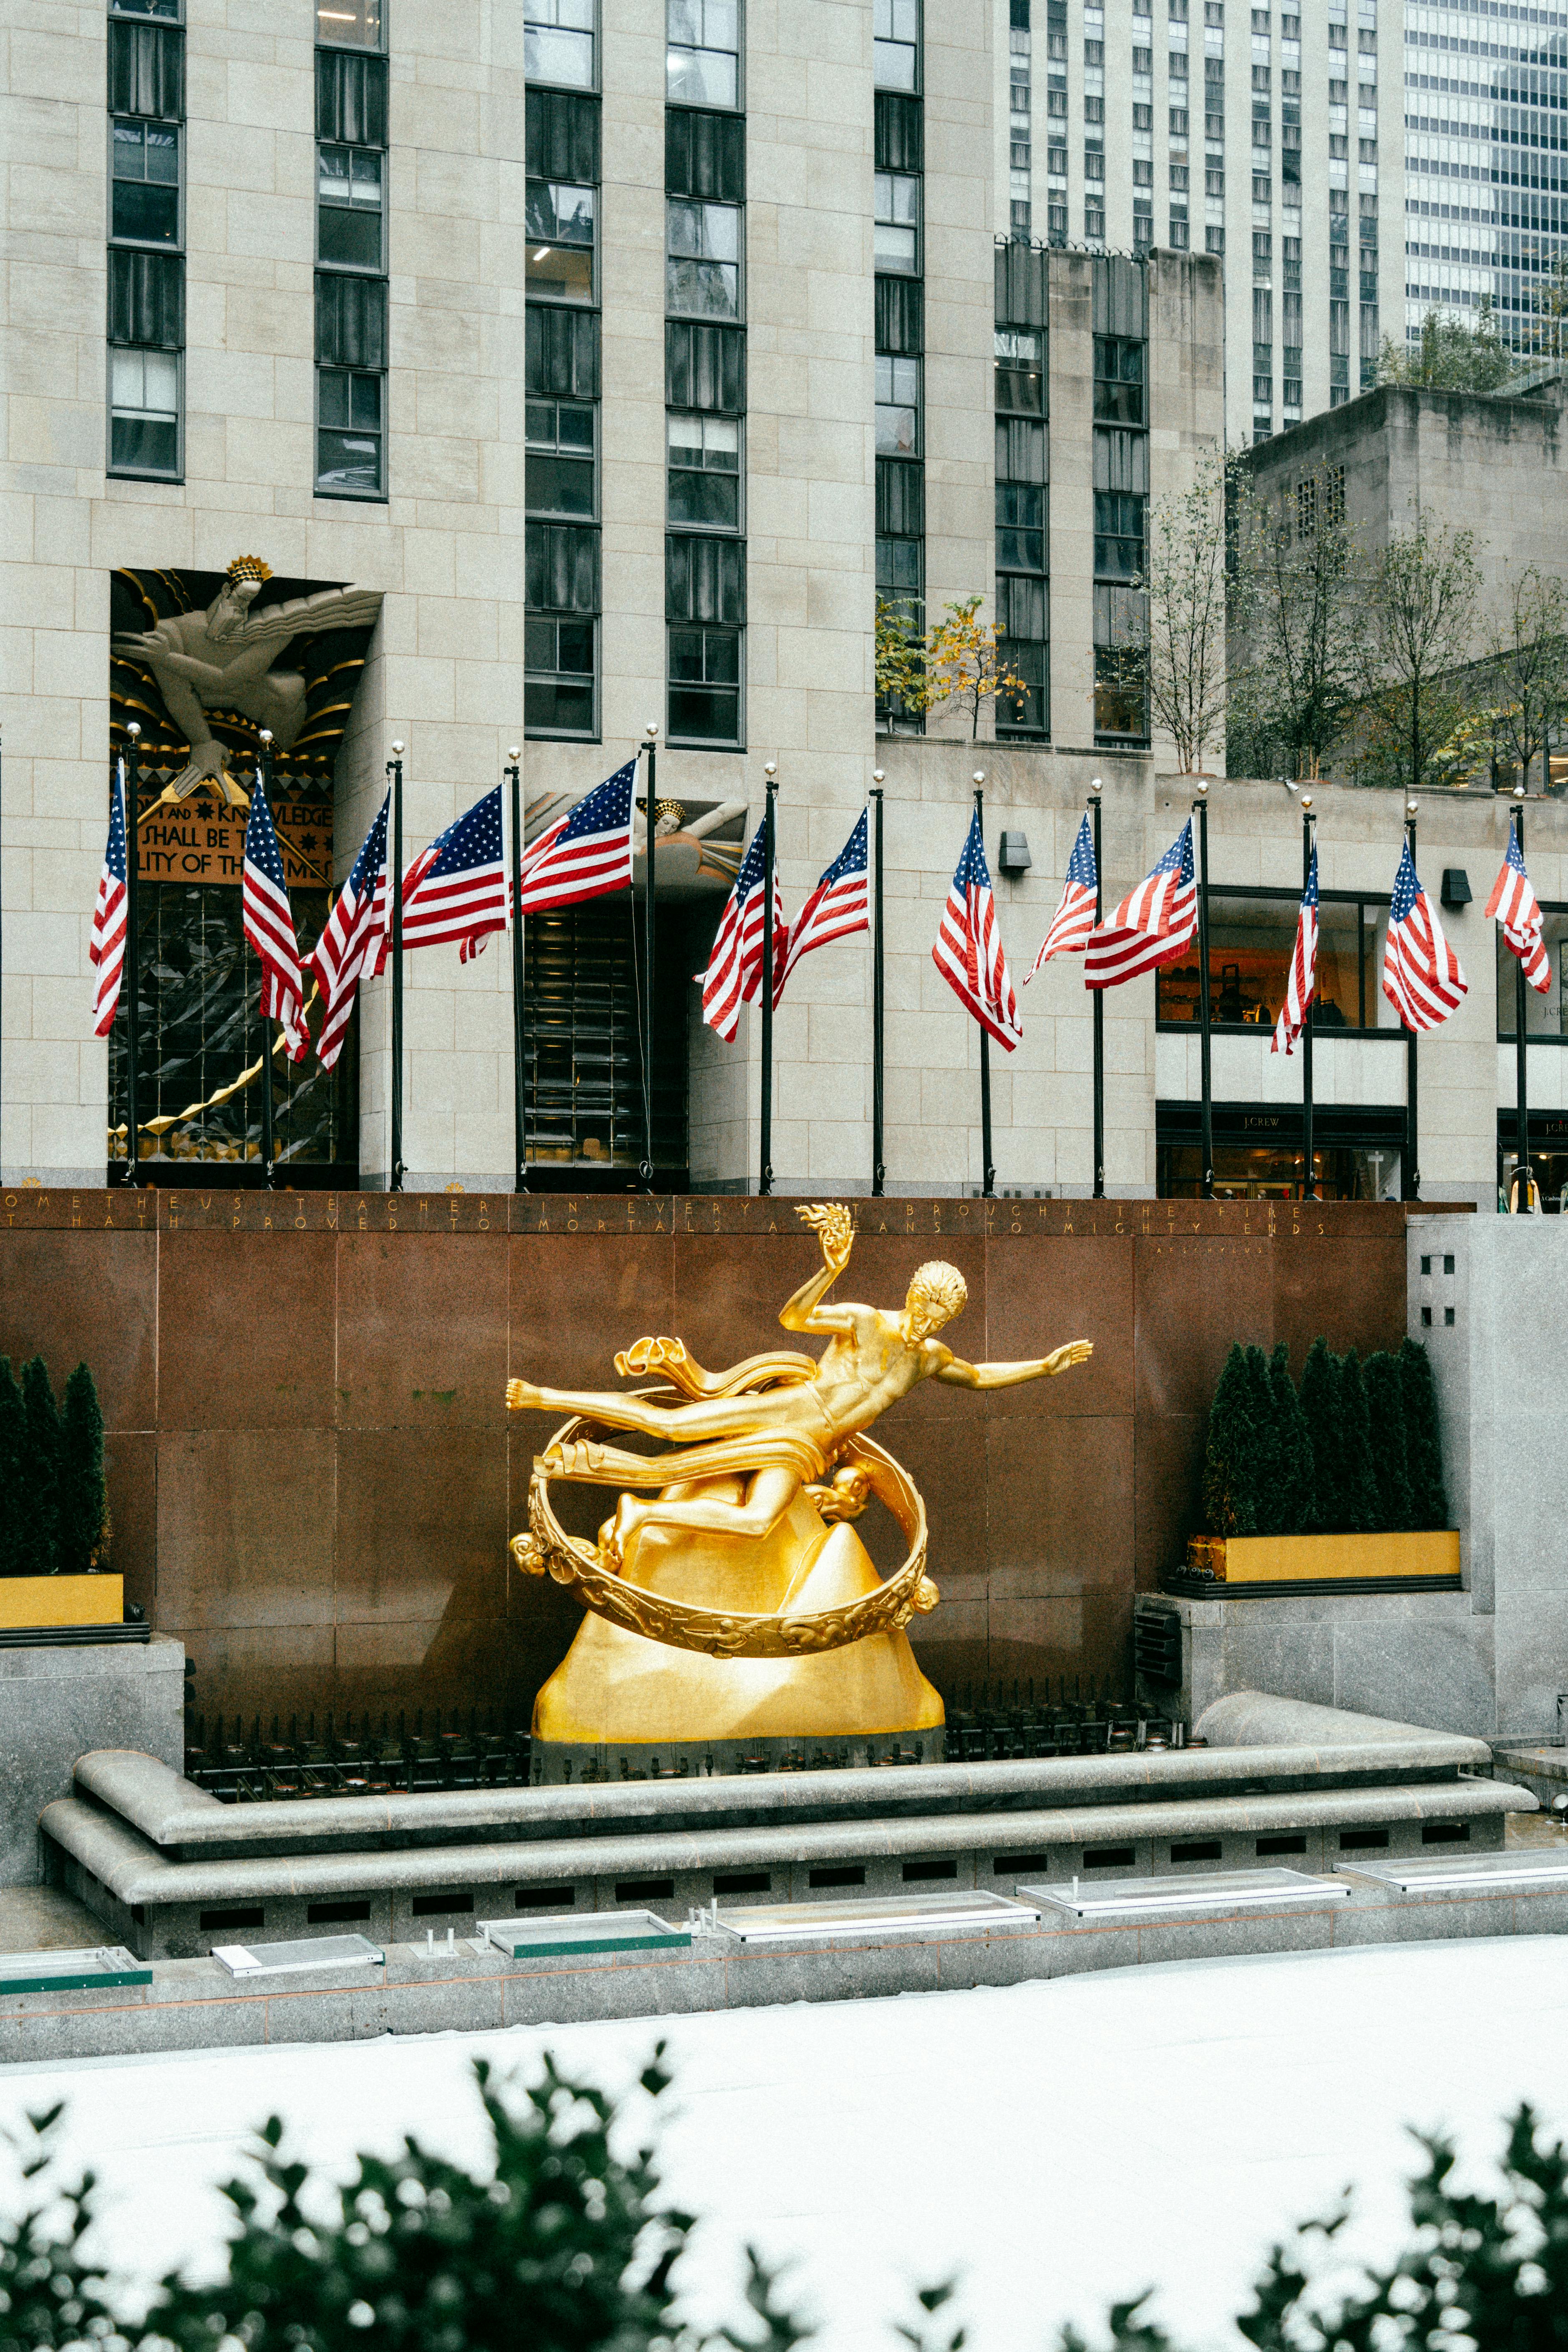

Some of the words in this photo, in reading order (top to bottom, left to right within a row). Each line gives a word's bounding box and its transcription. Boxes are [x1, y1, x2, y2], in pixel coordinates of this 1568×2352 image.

[167, 808, 191, 820] AND
[218, 802, 332, 828] KNWLEDGE
[142, 825, 201, 847] SHALL
[207, 828, 229, 848] BE
[182, 854, 211, 874] OF
[217, 855, 244, 875] TH
[1244, 1118, 1279, 1129] J.CREW
[297, 1198, 488, 1213] TEACHER
[542, 1202, 577, 1213] IN
[628, 1202, 749, 1214] EVERY
[906, 1204, 1072, 1216] BROUGHT
[1118, 1206, 1175, 1217] THE
[1219, 1206, 1299, 1218] FIRE
[73, 1216, 178, 1228] HATH
[233, 1216, 397, 1230] PROVED
[450, 1218, 489, 1230] TO
[539, 1219, 720, 1232] MORTALS
[769, 1221, 777, 1232] A
[853, 1221, 941, 1233] EANS
[985, 1222, 1021, 1233] TO
[1064, 1223, 1200, 1234] MIGHTY
[1244, 1223, 1324, 1234] ENDS
